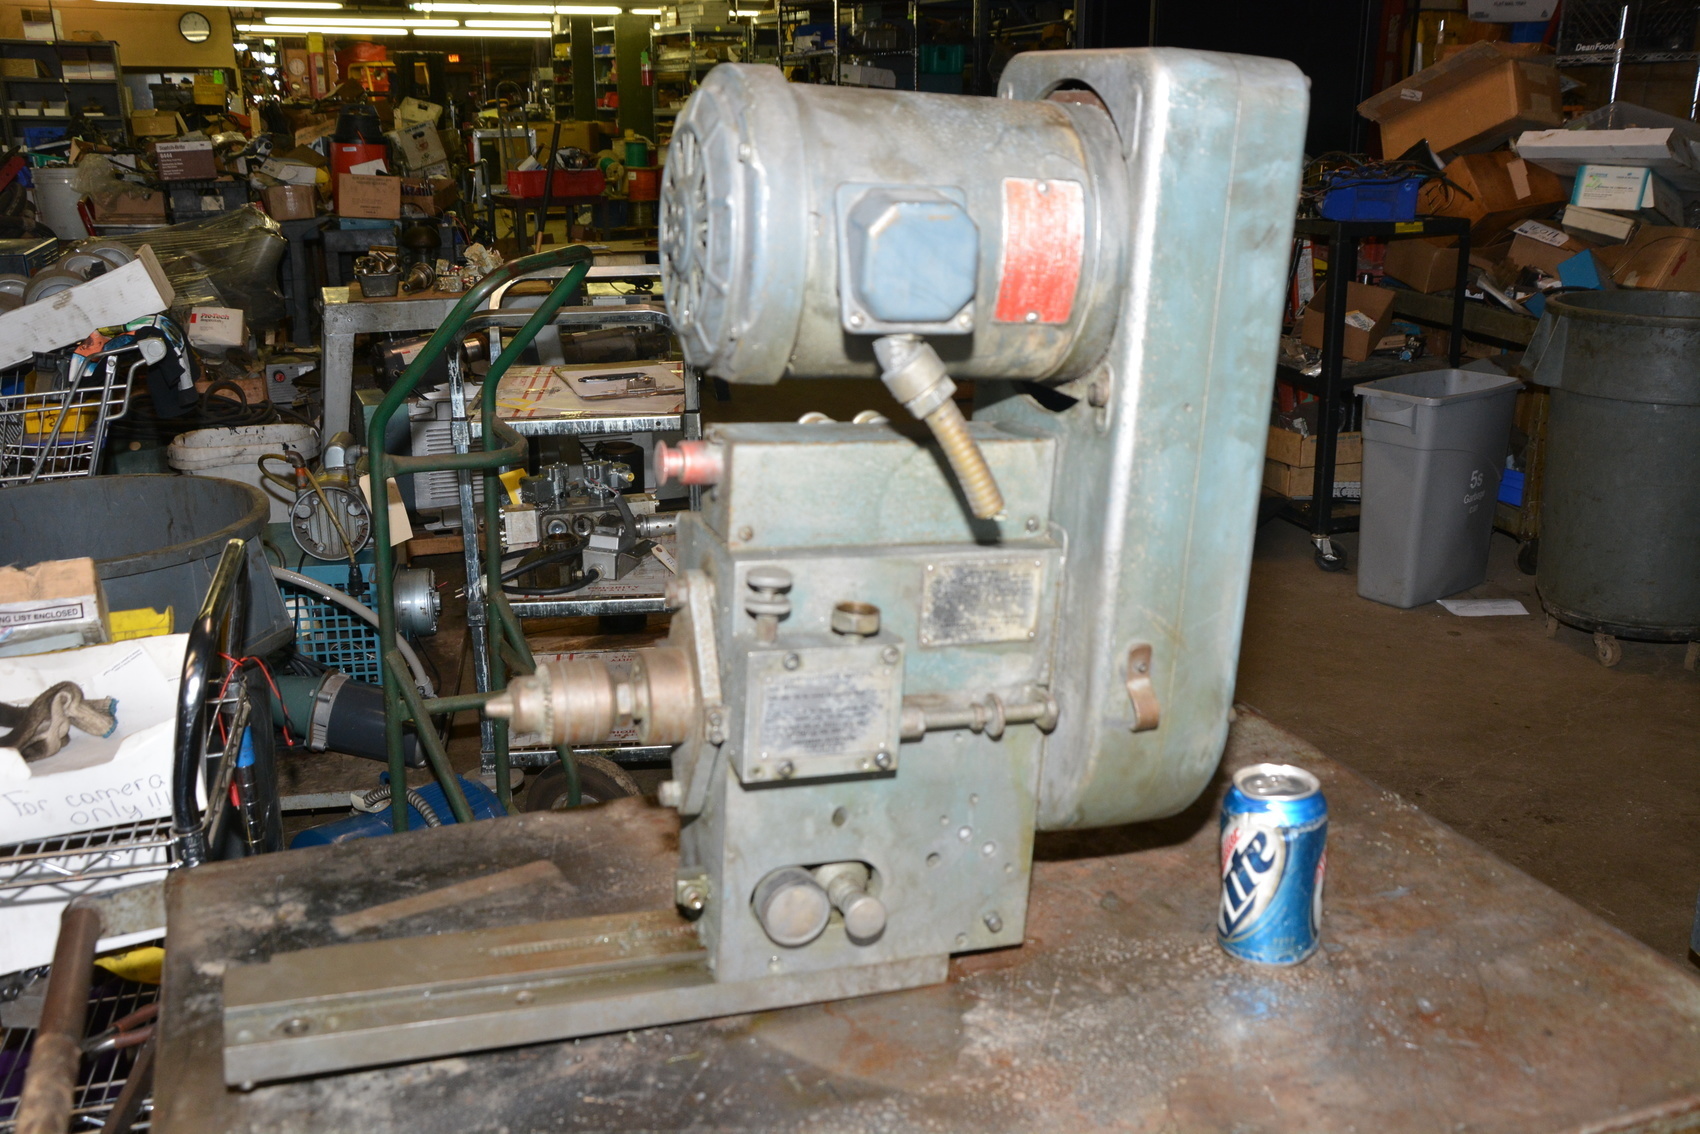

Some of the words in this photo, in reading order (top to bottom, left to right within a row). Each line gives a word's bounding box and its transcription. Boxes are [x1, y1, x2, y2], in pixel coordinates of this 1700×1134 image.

[13, 614, 31, 622] LIST
[34, 607, 79, 620] ENCLOSED
[2, 789, 48, 817] For
[65, 773, 165, 808] camera
